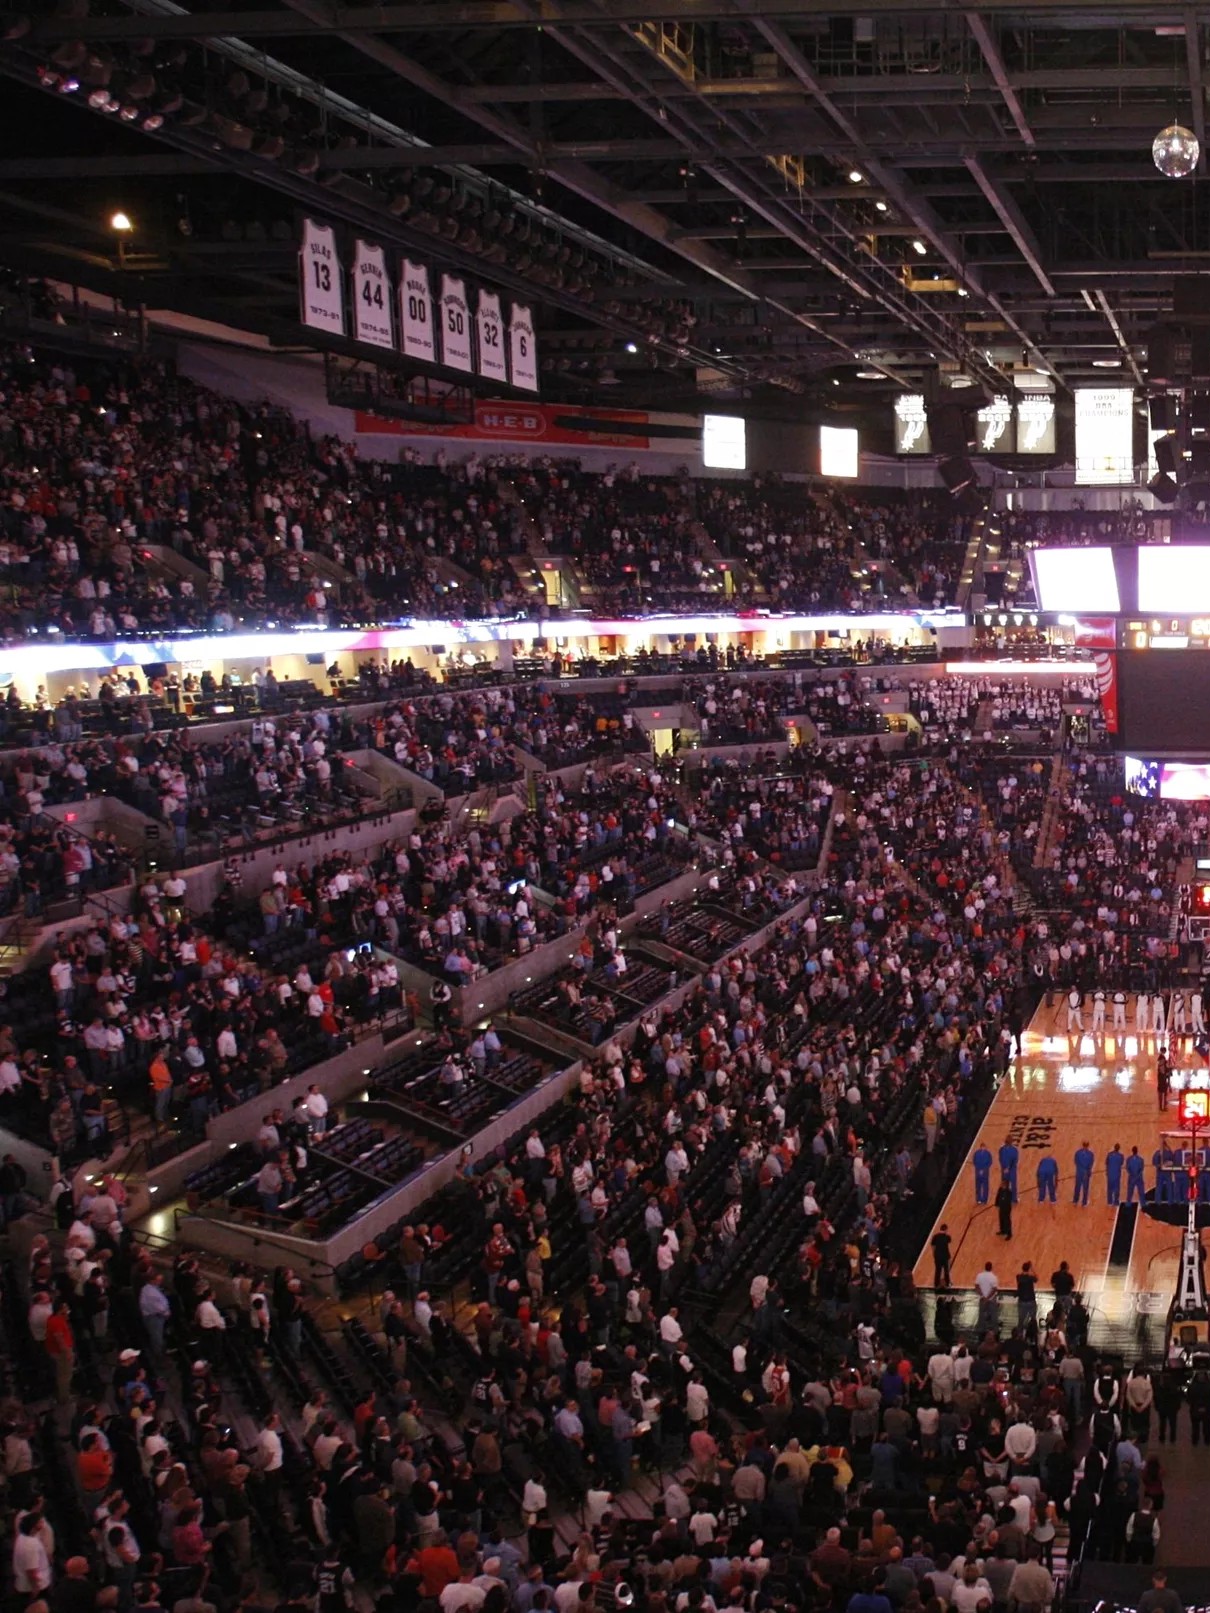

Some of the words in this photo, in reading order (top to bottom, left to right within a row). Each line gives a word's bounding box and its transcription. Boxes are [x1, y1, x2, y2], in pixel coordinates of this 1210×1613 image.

[313, 261, 331, 292] 13
[362, 280, 384, 310] 44
[409, 295, 426, 323] 00
[448, 308, 464, 336] 50
[484, 321, 499, 347] 32
[520, 335, 527, 357] 6
[1008, 1115, 1030, 1148] CENTE
[1021, 1116, 1057, 1150] at&t
